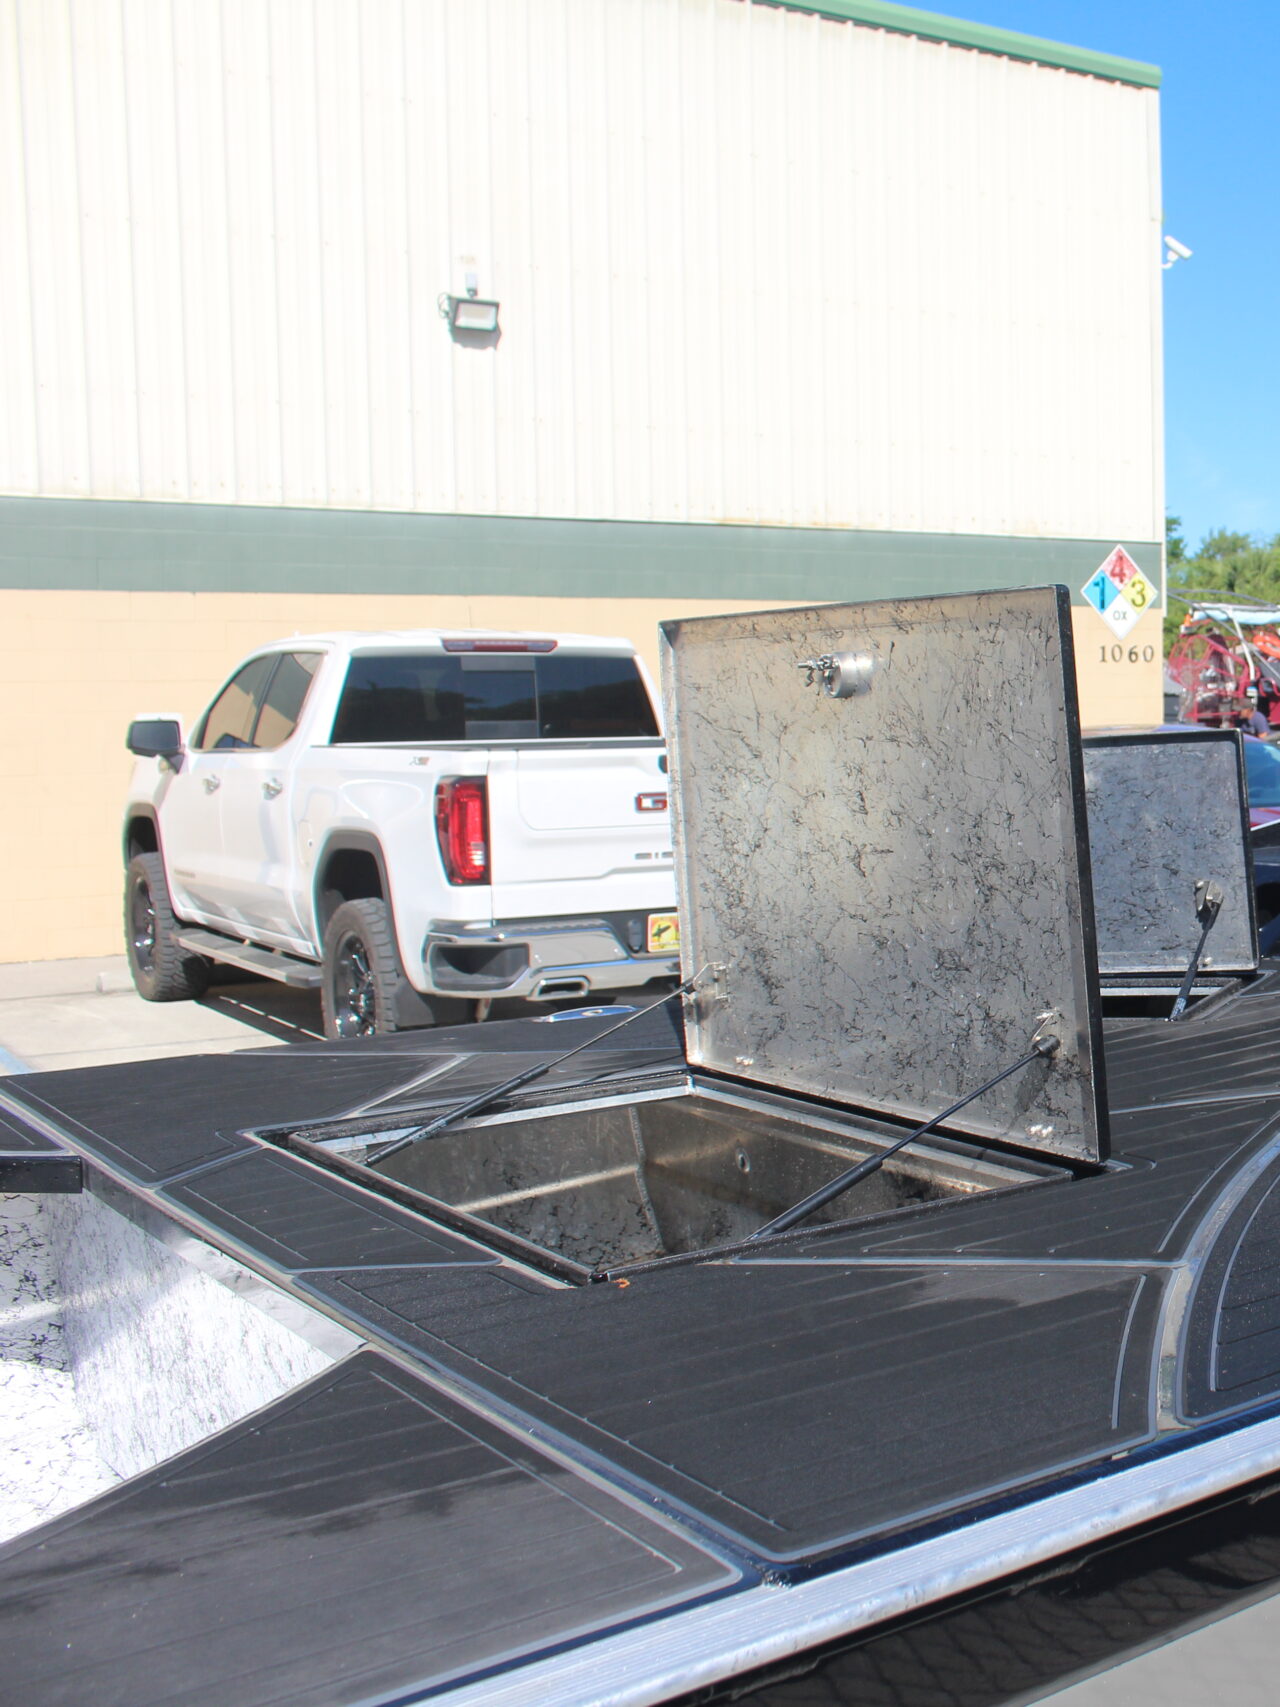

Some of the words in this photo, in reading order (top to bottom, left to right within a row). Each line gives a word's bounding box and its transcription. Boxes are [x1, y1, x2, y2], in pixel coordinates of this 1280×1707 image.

[1110, 555, 1126, 583] 4
[1093, 577, 1106, 609] 1
[1131, 580, 1146, 607] 3
[1099, 644, 1155, 663] 1060
